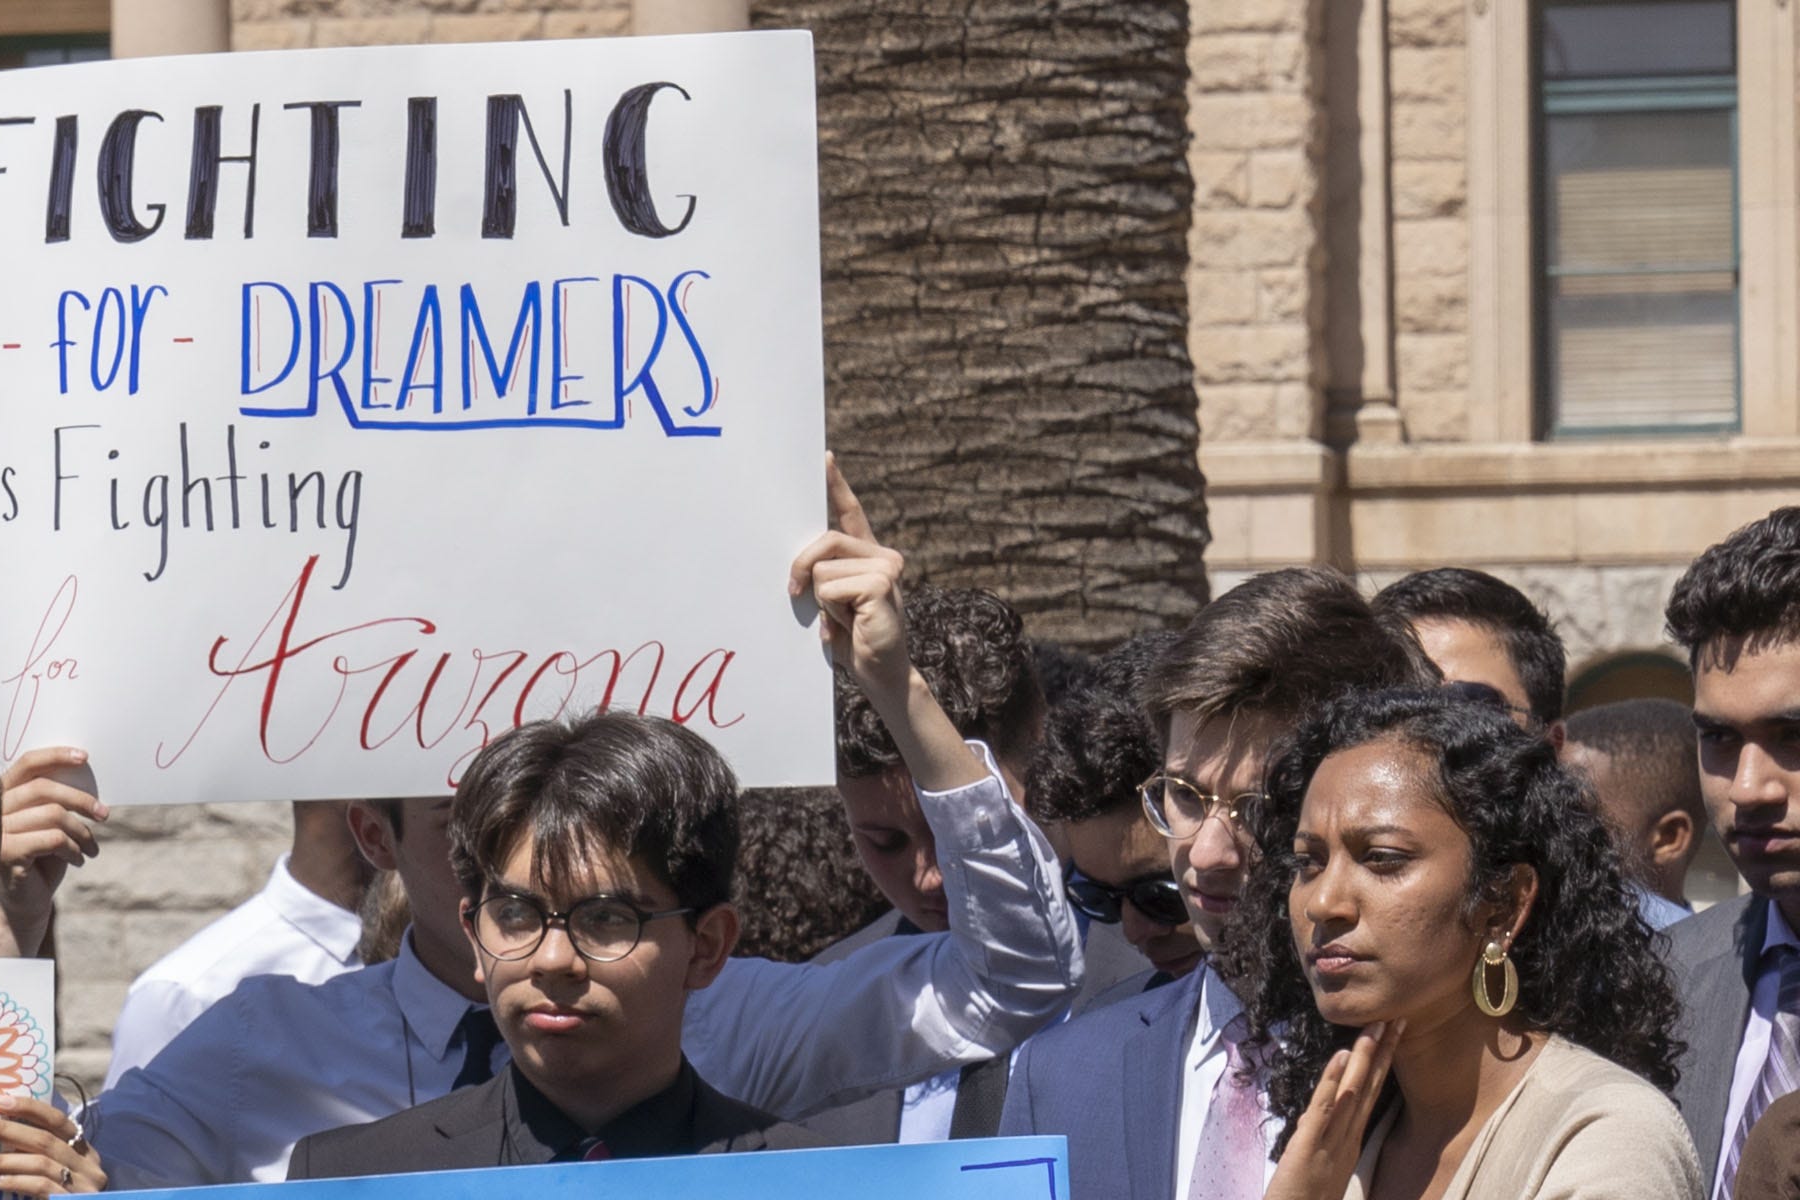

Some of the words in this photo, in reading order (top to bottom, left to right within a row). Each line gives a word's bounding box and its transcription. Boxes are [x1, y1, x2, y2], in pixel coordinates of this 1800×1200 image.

[240, 270, 722, 437] DREAMERS
[53, 423, 364, 590] Fighting
[1, 574, 80, 762] for
[157, 554, 746, 788] Arizona
